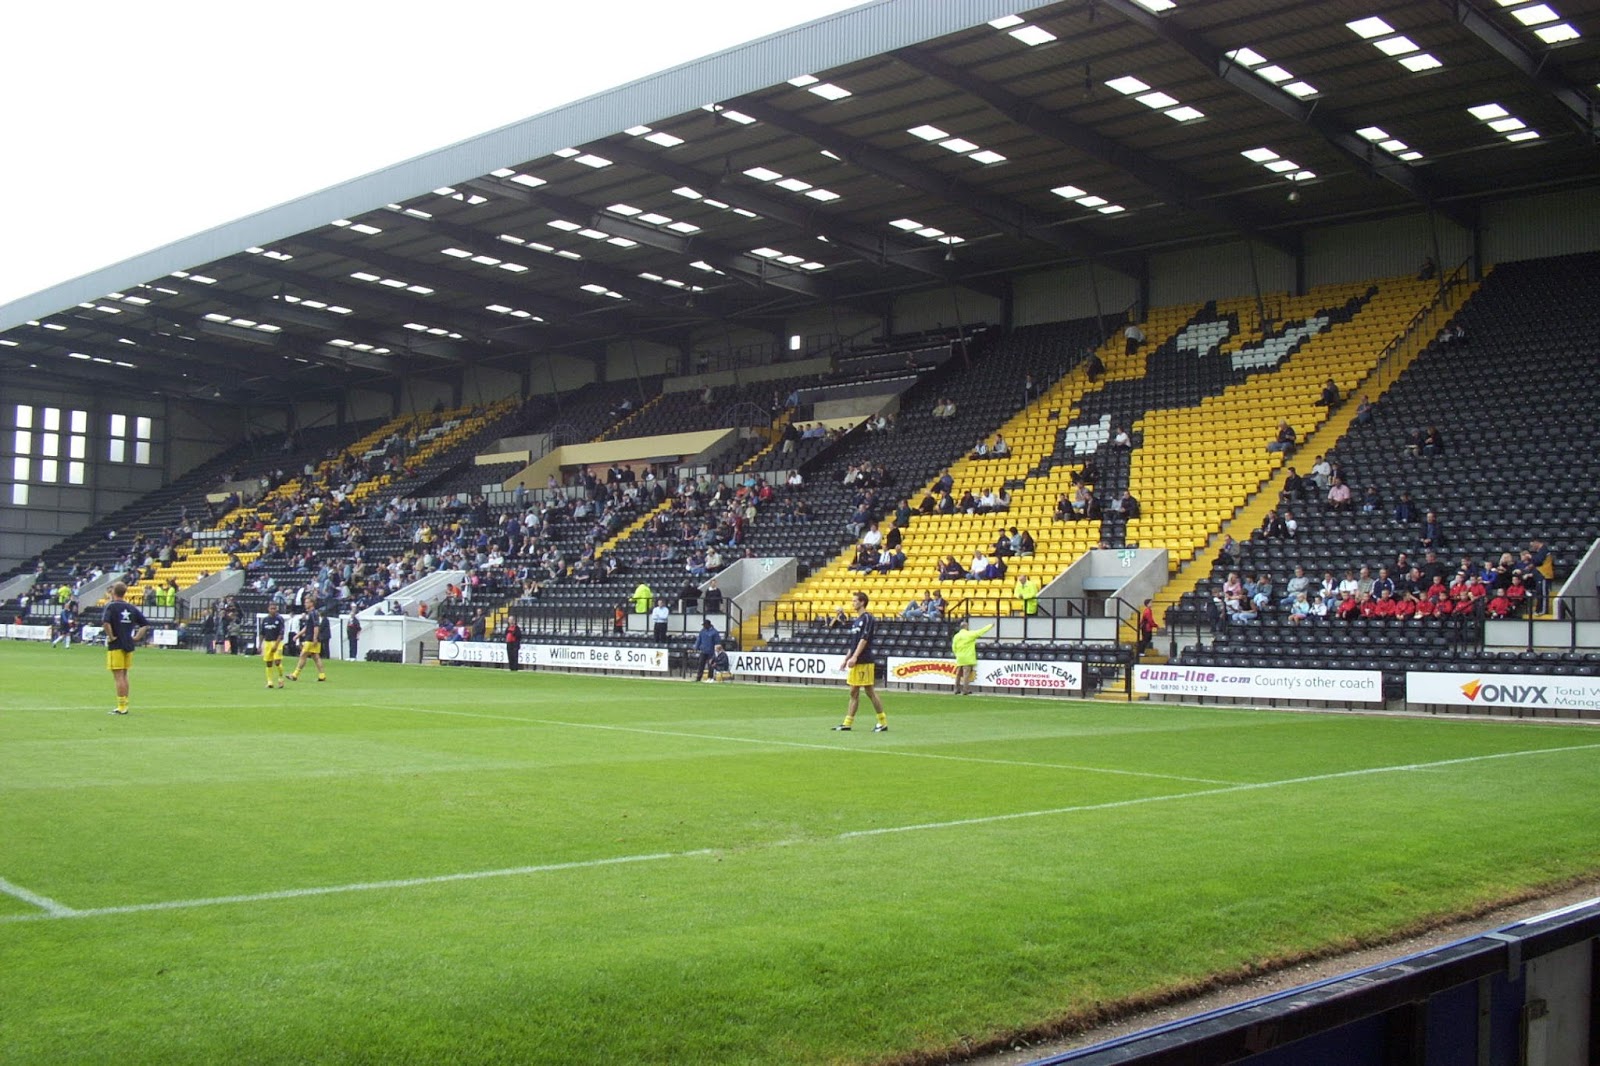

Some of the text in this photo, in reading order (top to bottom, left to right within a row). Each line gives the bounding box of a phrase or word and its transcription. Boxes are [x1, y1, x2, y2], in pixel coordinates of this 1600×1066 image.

[462, 649, 482, 660] 0115
[490, 651, 504, 661] 913
[550, 648, 585, 660] William
[590, 649, 609, 661] Bee
[614, 650, 622, 662] &
[627, 651, 647, 662] Son
[735, 656, 784, 671] ARRIVA
[788, 658, 826, 674] FORD
[985, 662, 1077, 685] THE WINNING TEAM
[996, 678, 1020, 686] 0800
[1254, 674, 1302, 691] County's
[1304, 676, 1335, 689] other
[1339, 677, 1375, 690] coach
[1481, 684, 1548, 704] ONYX
[1554, 686, 1585, 696] Total
